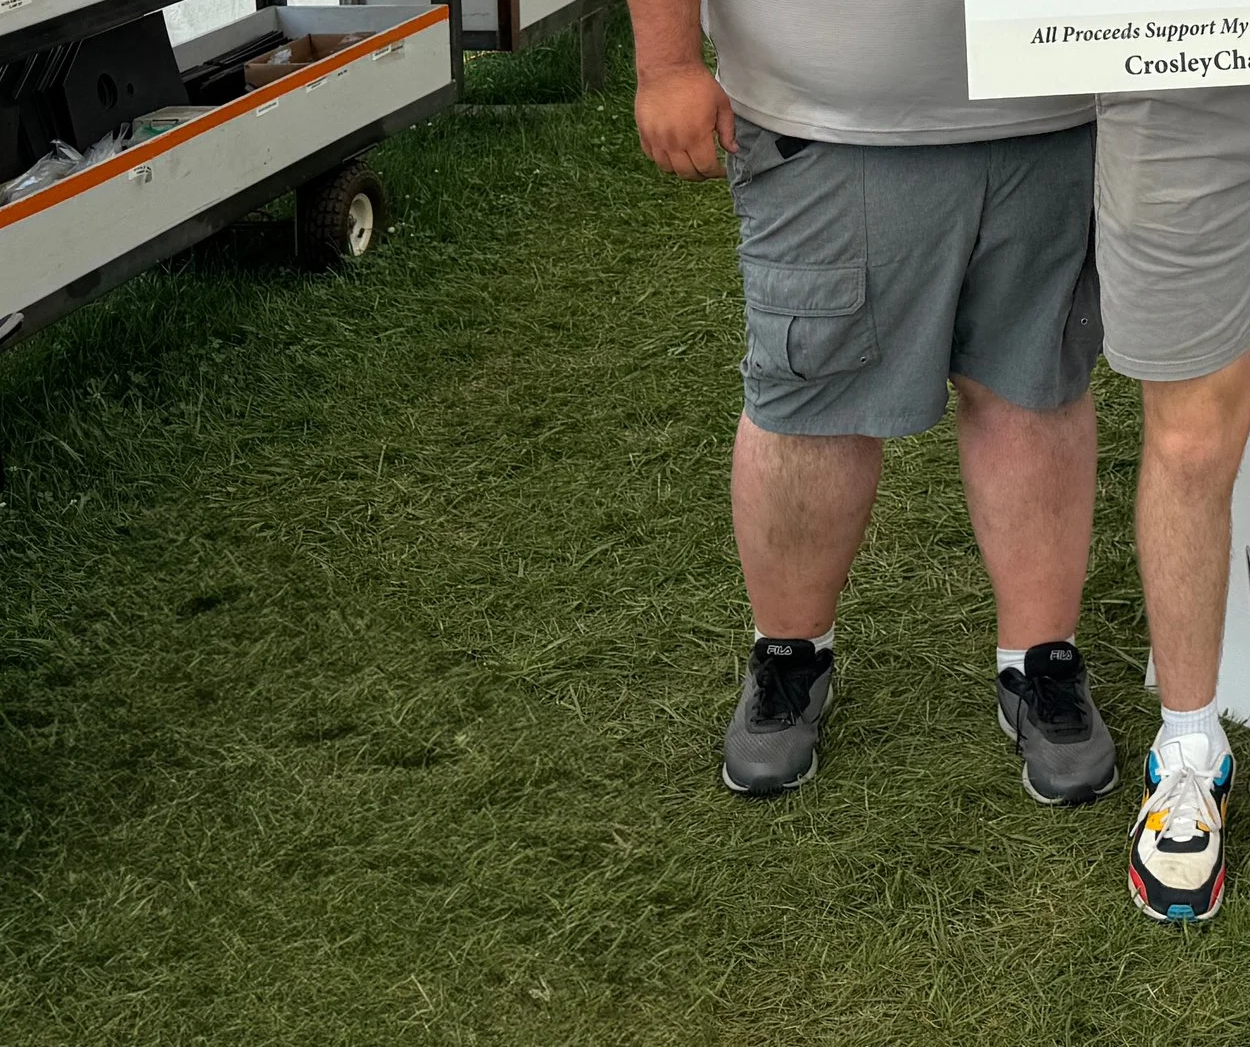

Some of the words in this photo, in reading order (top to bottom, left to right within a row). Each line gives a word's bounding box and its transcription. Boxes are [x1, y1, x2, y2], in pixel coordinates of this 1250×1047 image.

[1031, 26, 1057, 44] All
[1063, 22, 1140, 43] Proceeds
[1145, 20, 1216, 42] Support
[1220, 18, 1249, 38] My
[766, 644, 793, 656] FILA
[1049, 649, 1073, 661] FILA
